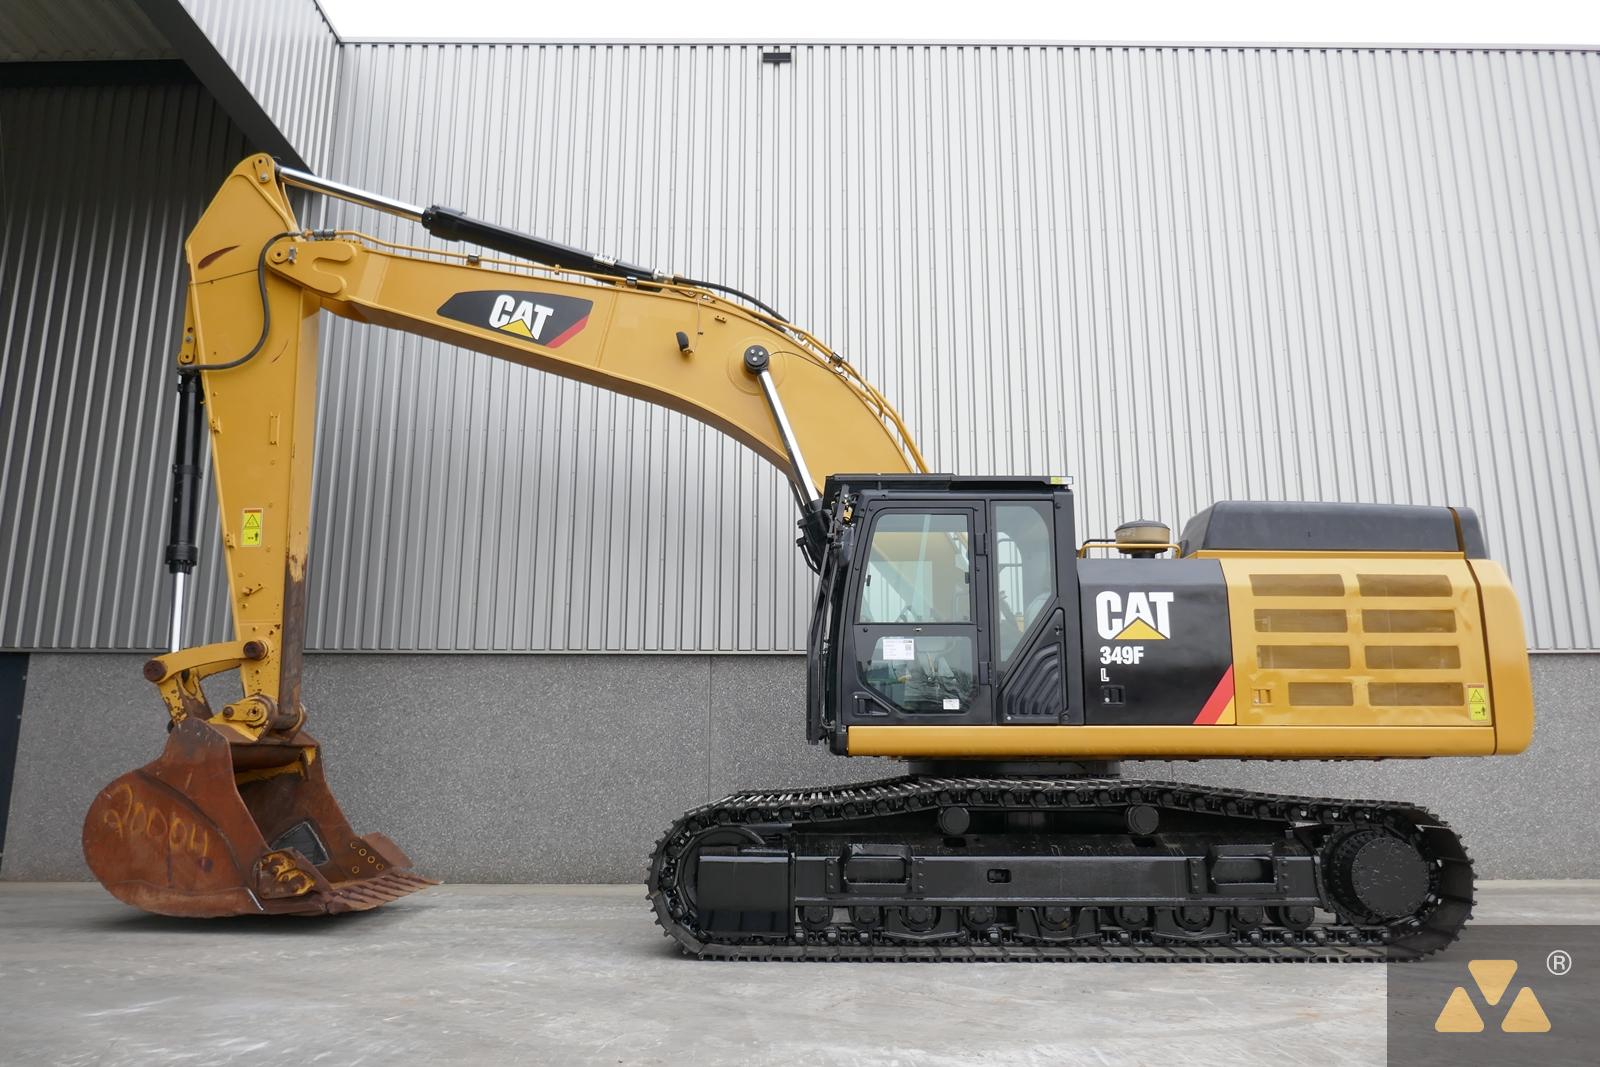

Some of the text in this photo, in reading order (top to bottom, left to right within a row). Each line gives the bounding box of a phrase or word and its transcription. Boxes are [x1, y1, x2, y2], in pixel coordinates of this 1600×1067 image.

[489, 294, 554, 340] CAT
[1096, 591, 1174, 640] CAT
[1100, 646, 1144, 664] 349F
[1101, 668, 1110, 682] L
